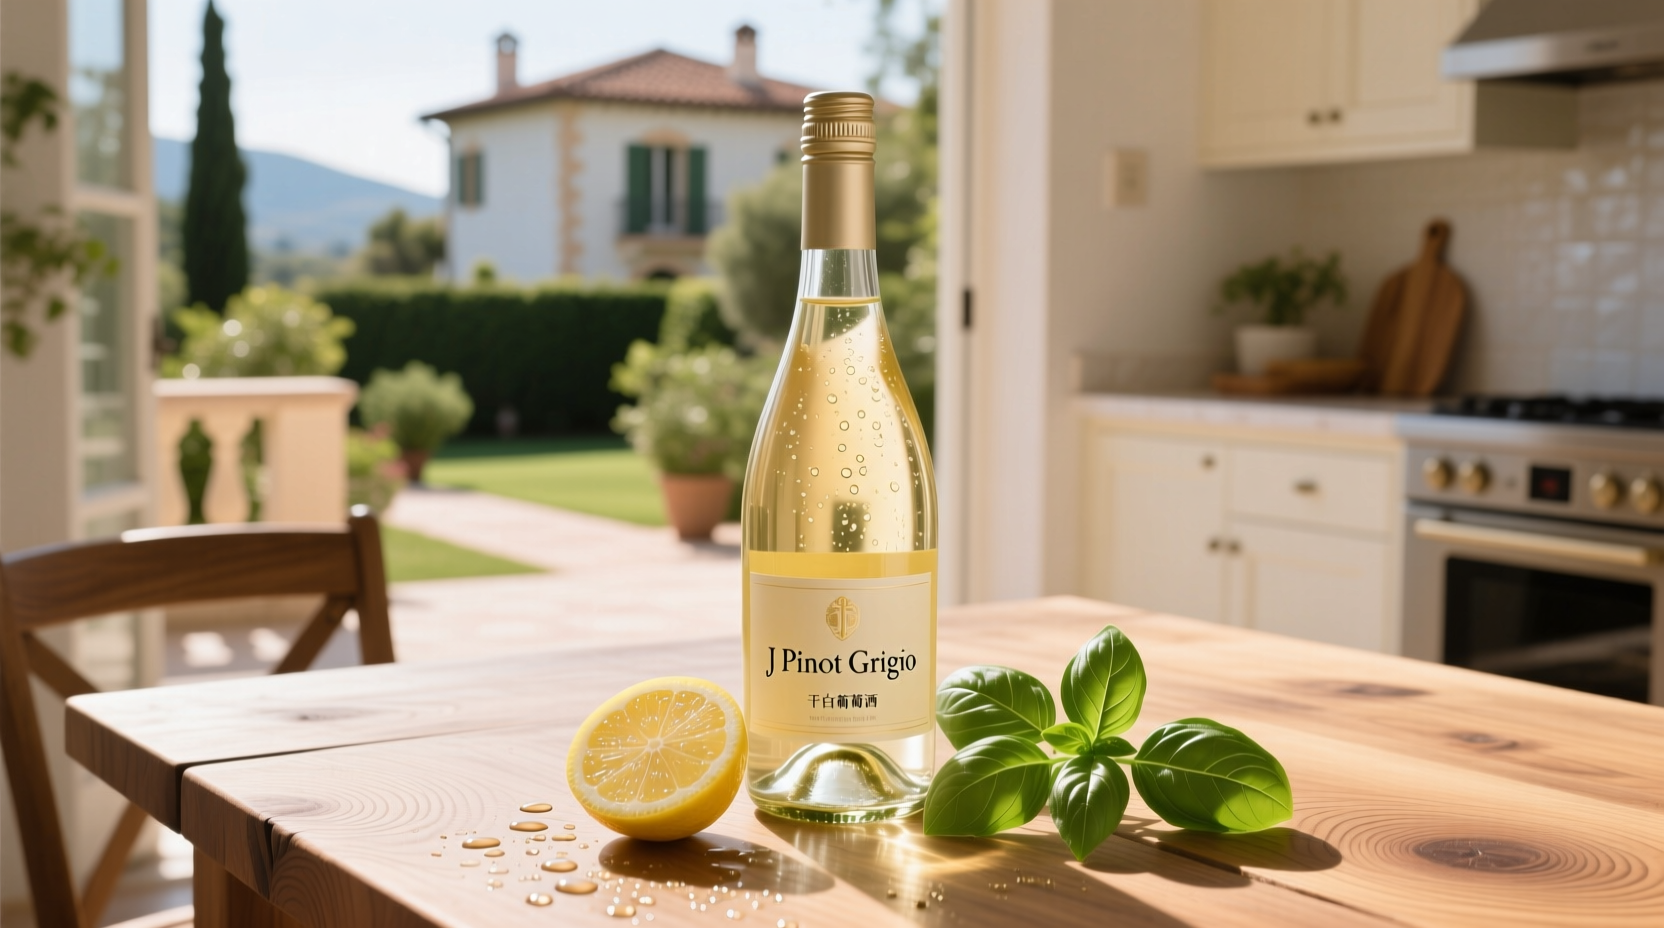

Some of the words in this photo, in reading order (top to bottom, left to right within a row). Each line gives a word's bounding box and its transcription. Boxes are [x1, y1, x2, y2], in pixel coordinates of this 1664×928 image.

[766, 646, 776, 678] J
[782, 648, 843, 674] Pinot
[849, 649, 917, 680] Grigio
